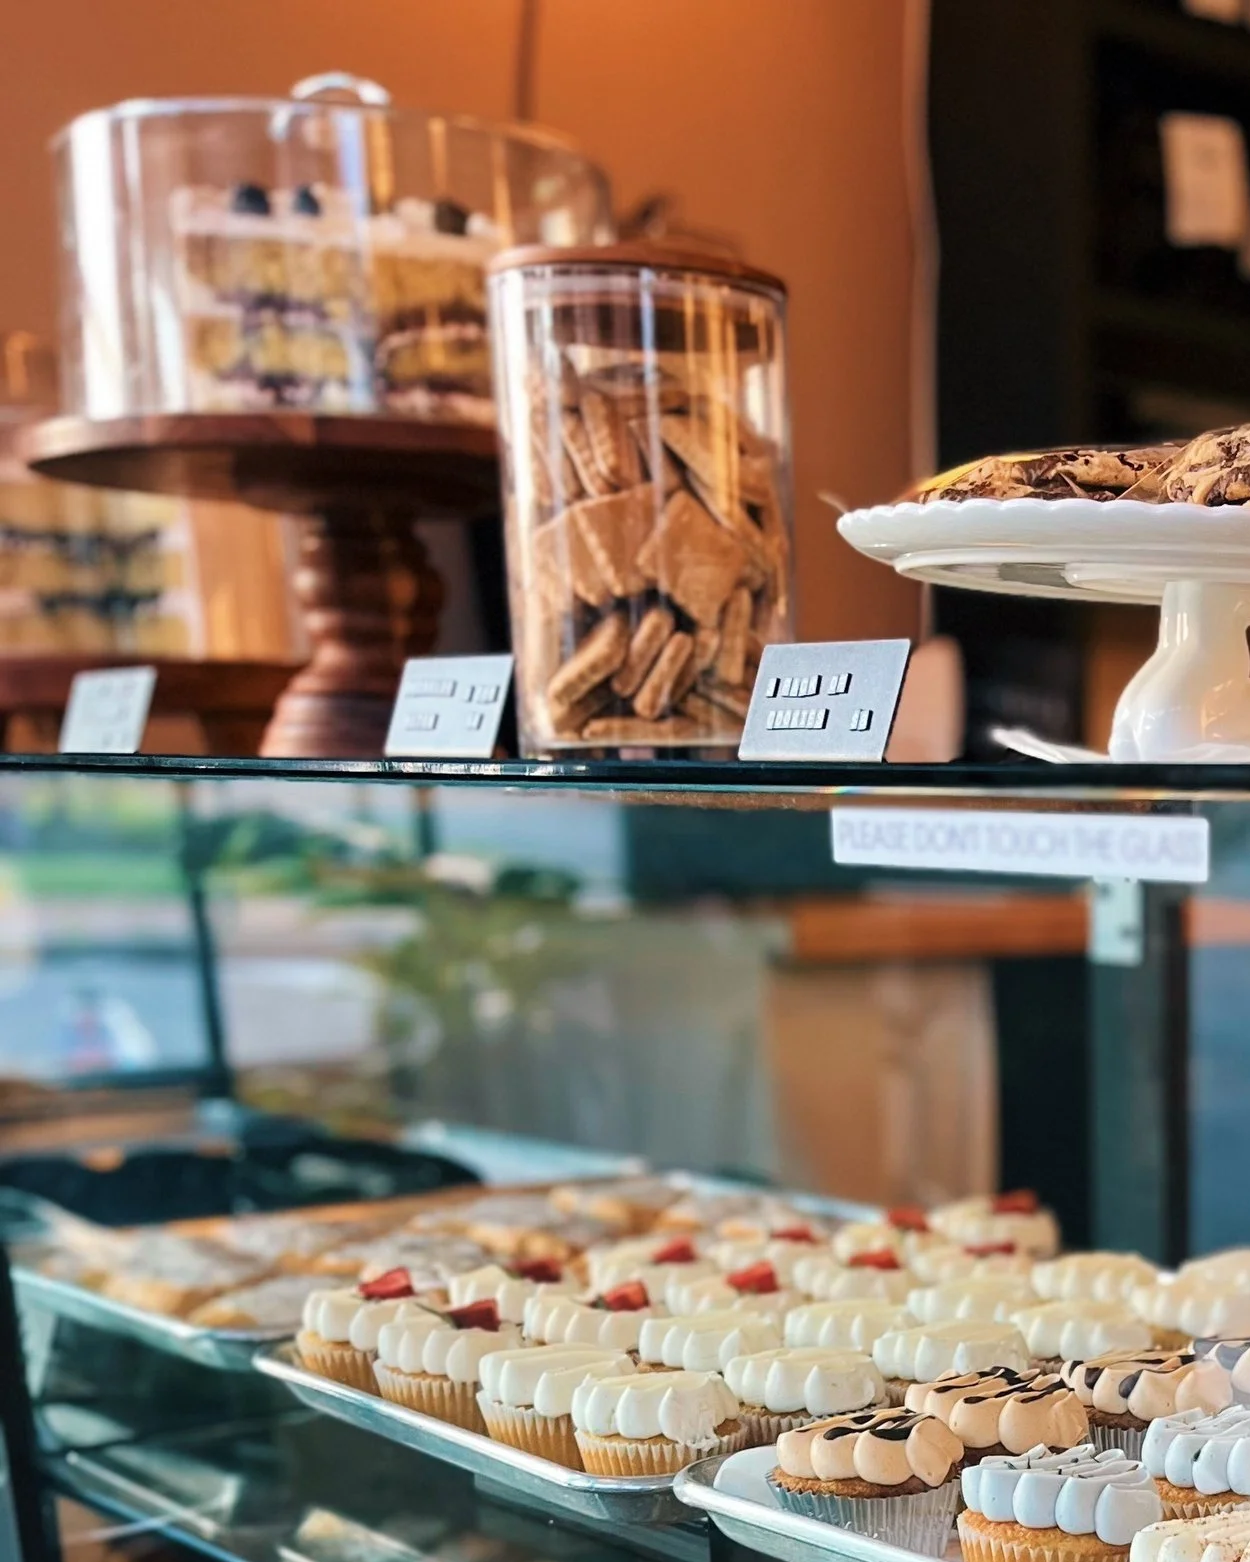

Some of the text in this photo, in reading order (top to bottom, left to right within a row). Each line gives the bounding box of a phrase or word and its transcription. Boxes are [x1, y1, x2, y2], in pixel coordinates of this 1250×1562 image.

[837, 819, 908, 851] PLEASE
[986, 825, 1068, 859] TOUCH
[1074, 826, 1115, 861] THE
